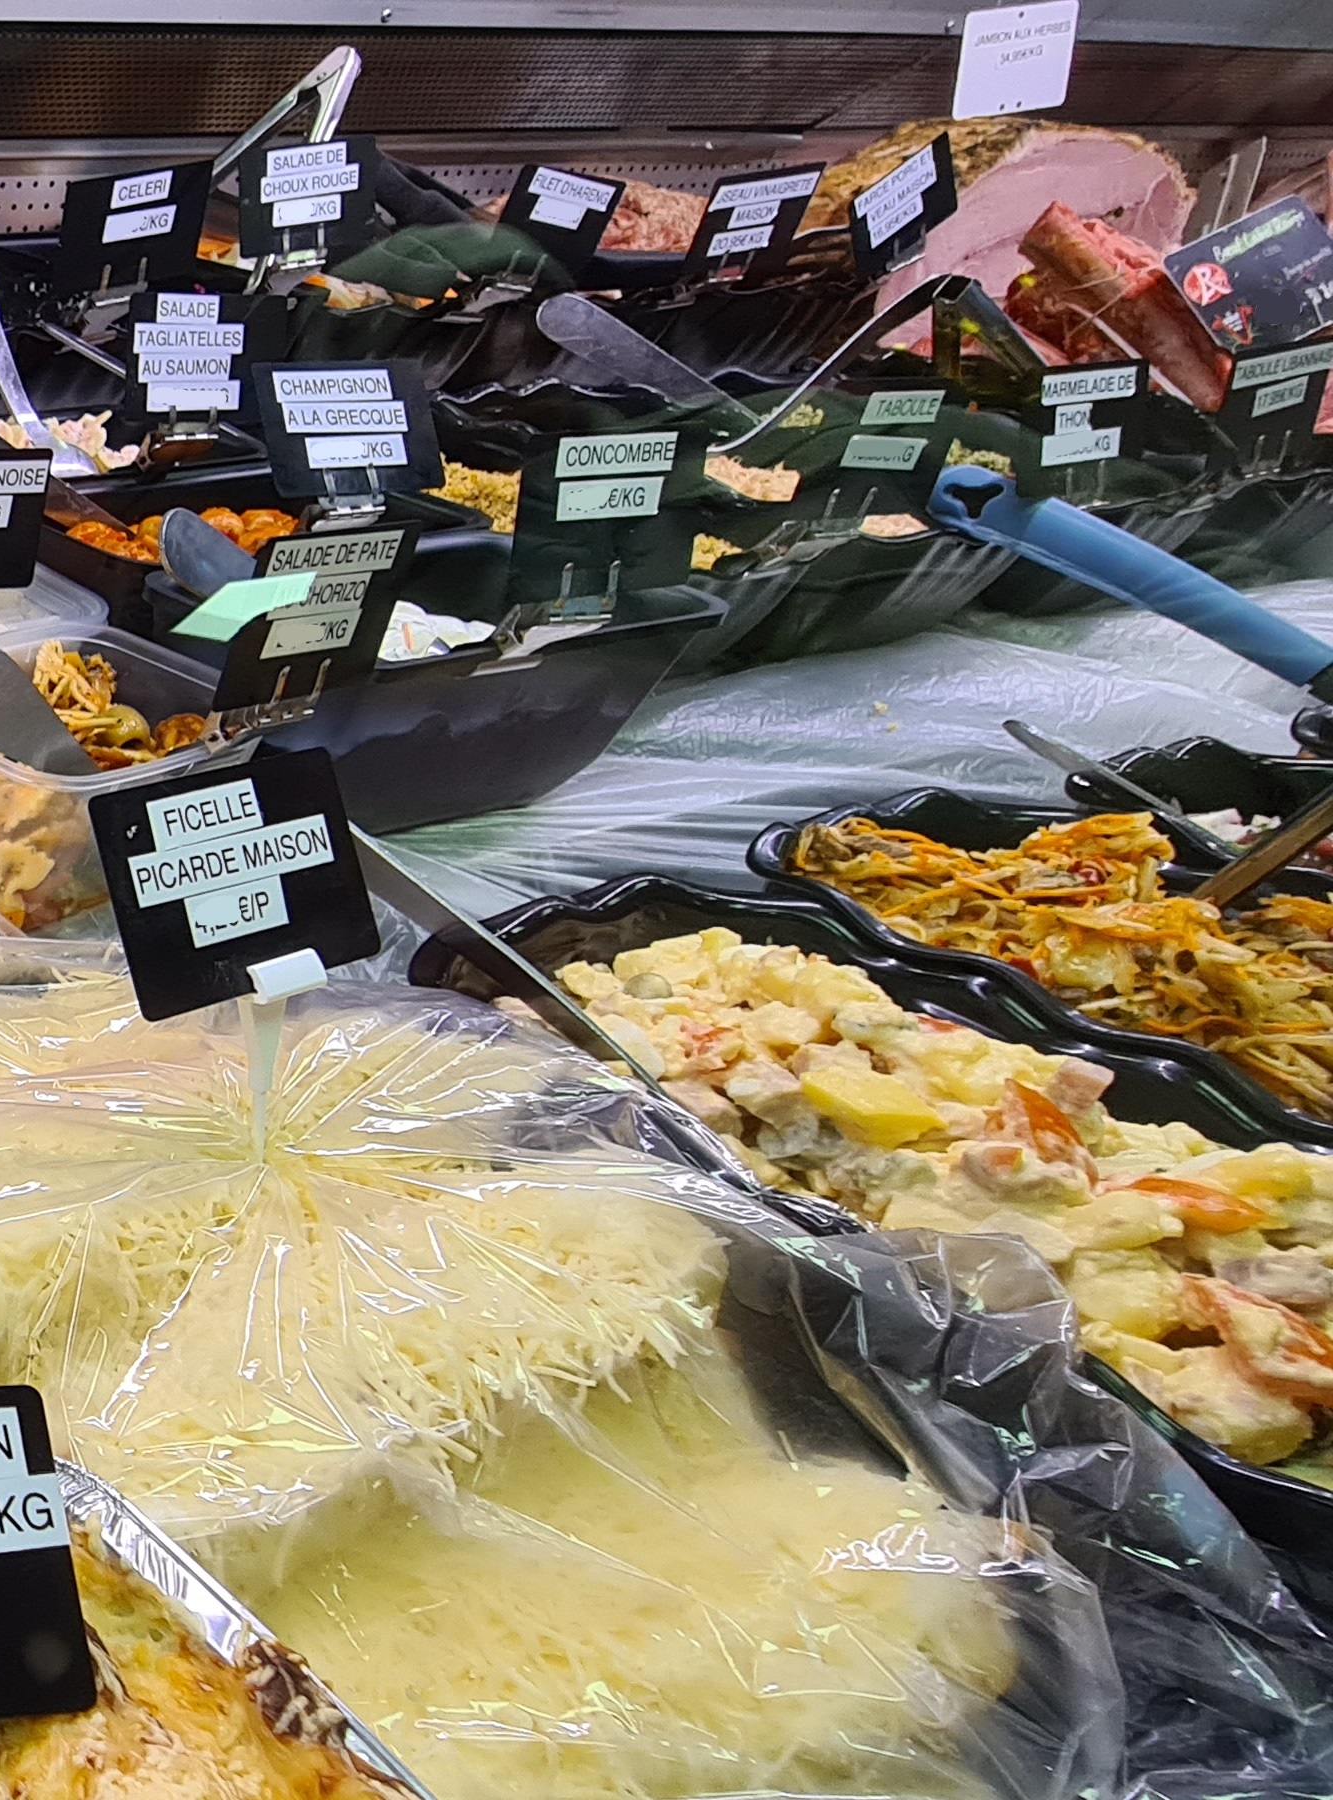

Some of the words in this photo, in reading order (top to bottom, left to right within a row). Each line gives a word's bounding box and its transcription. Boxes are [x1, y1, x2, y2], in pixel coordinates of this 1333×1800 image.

[273, 151, 323, 171] SALADE
[327, 149, 343, 163] DE
[118, 178, 167, 201] CELERI
[263, 178, 309, 197] CHOUX
[312, 170, 357, 189] ROUGE
[533, 173, 562, 192] FILET
[897, 171, 934, 200] MAISON
[735, 206, 775, 221] MAISON
[159, 300, 216, 318] SALADE
[137, 330, 242, 347] TAGLIATELLES
[142, 360, 162, 375] AU
[165, 358, 229, 375] SAUMON
[280, 377, 389, 396] CHAMPIGNON
[1042, 376, 1116, 399] MARMELADE
[1118, 374, 1134, 391] DE
[288, 410, 299, 426] A
[301, 409, 323, 425] LA
[325, 408, 405, 426] GRECQUE
[876, 397, 940, 417] TABOULE
[565, 441, 675, 467] CONCOMBRE
[272, 545, 336, 572] SALADE
[335, 542, 359, 565] DE
[357, 538, 398, 563] PATE
[163, 791, 257, 837] FICELLE
[136, 846, 240, 896] PICARDE
[241, 825, 329, 869] MAISON
